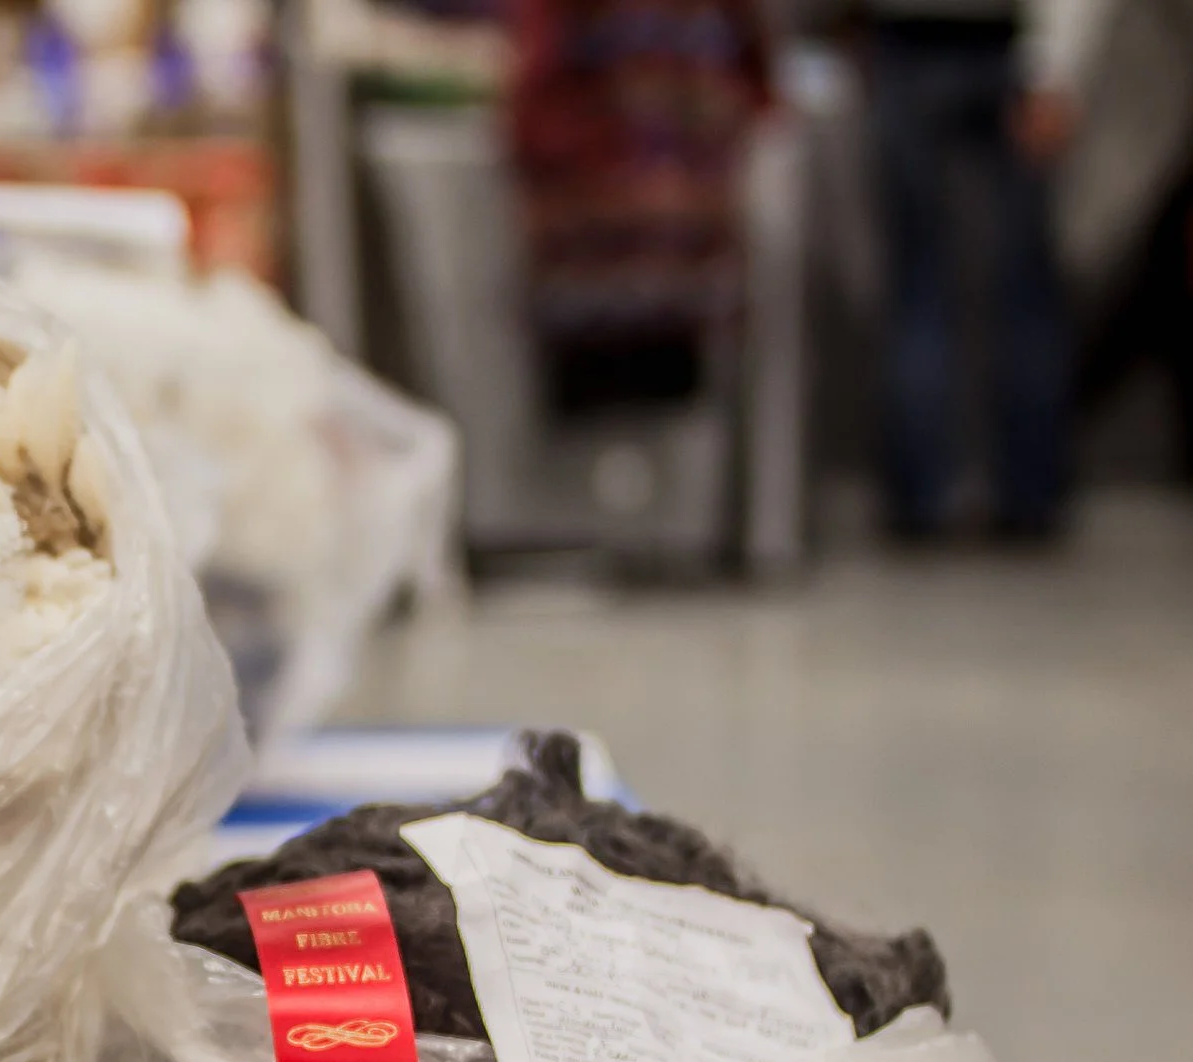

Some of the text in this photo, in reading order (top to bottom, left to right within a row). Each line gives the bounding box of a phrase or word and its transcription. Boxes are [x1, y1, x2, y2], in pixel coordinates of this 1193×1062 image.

[261, 901, 379, 923] MANITOBA
[296, 931, 362, 949] FIBRE
[282, 963, 391, 986] FESTIVAL
